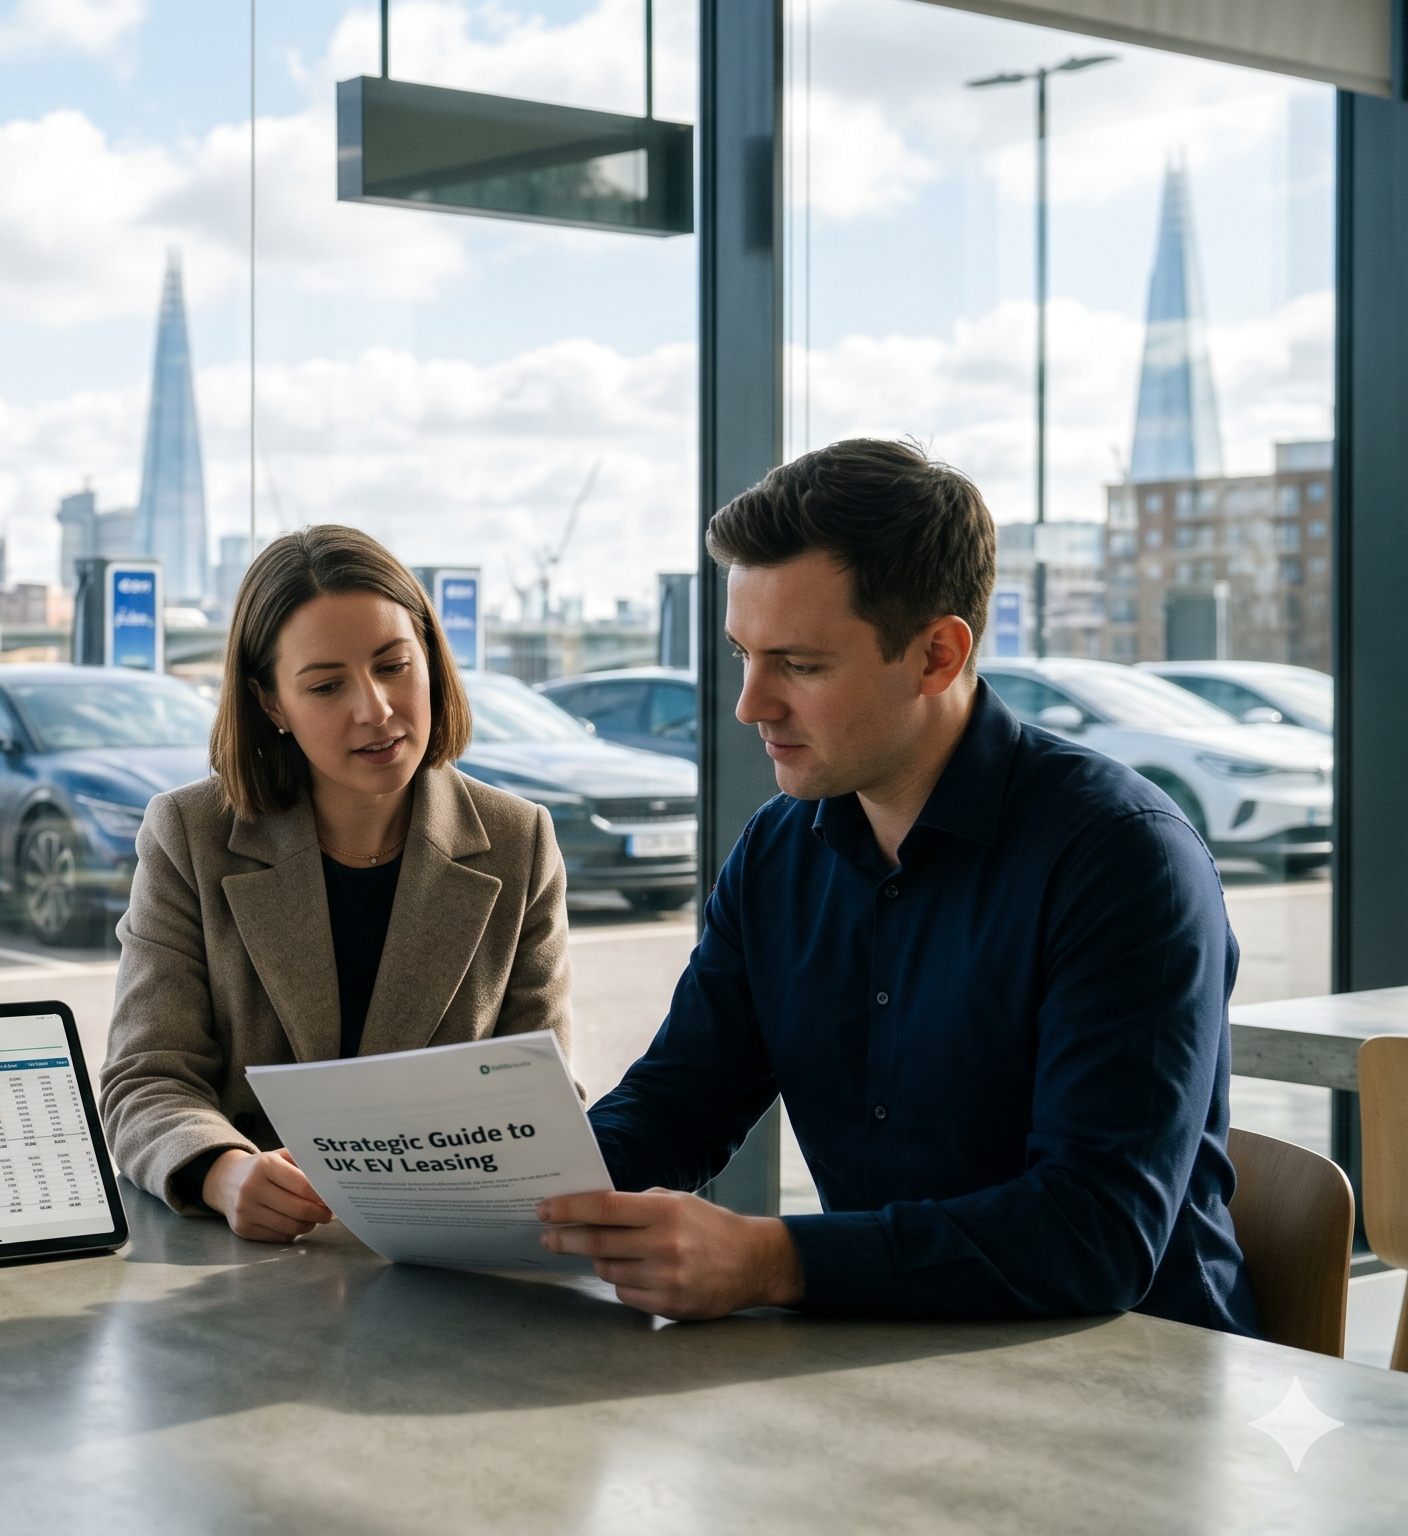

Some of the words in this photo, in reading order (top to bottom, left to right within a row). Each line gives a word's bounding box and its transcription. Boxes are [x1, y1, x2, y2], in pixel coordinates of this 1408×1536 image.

[312, 1133, 424, 1155] Strategic
[428, 1125, 503, 1149] Guide
[507, 1123, 536, 1140] to
[324, 1157, 362, 1172] UK
[363, 1158, 394, 1172] EV
[400, 1153, 499, 1173] Leasing
